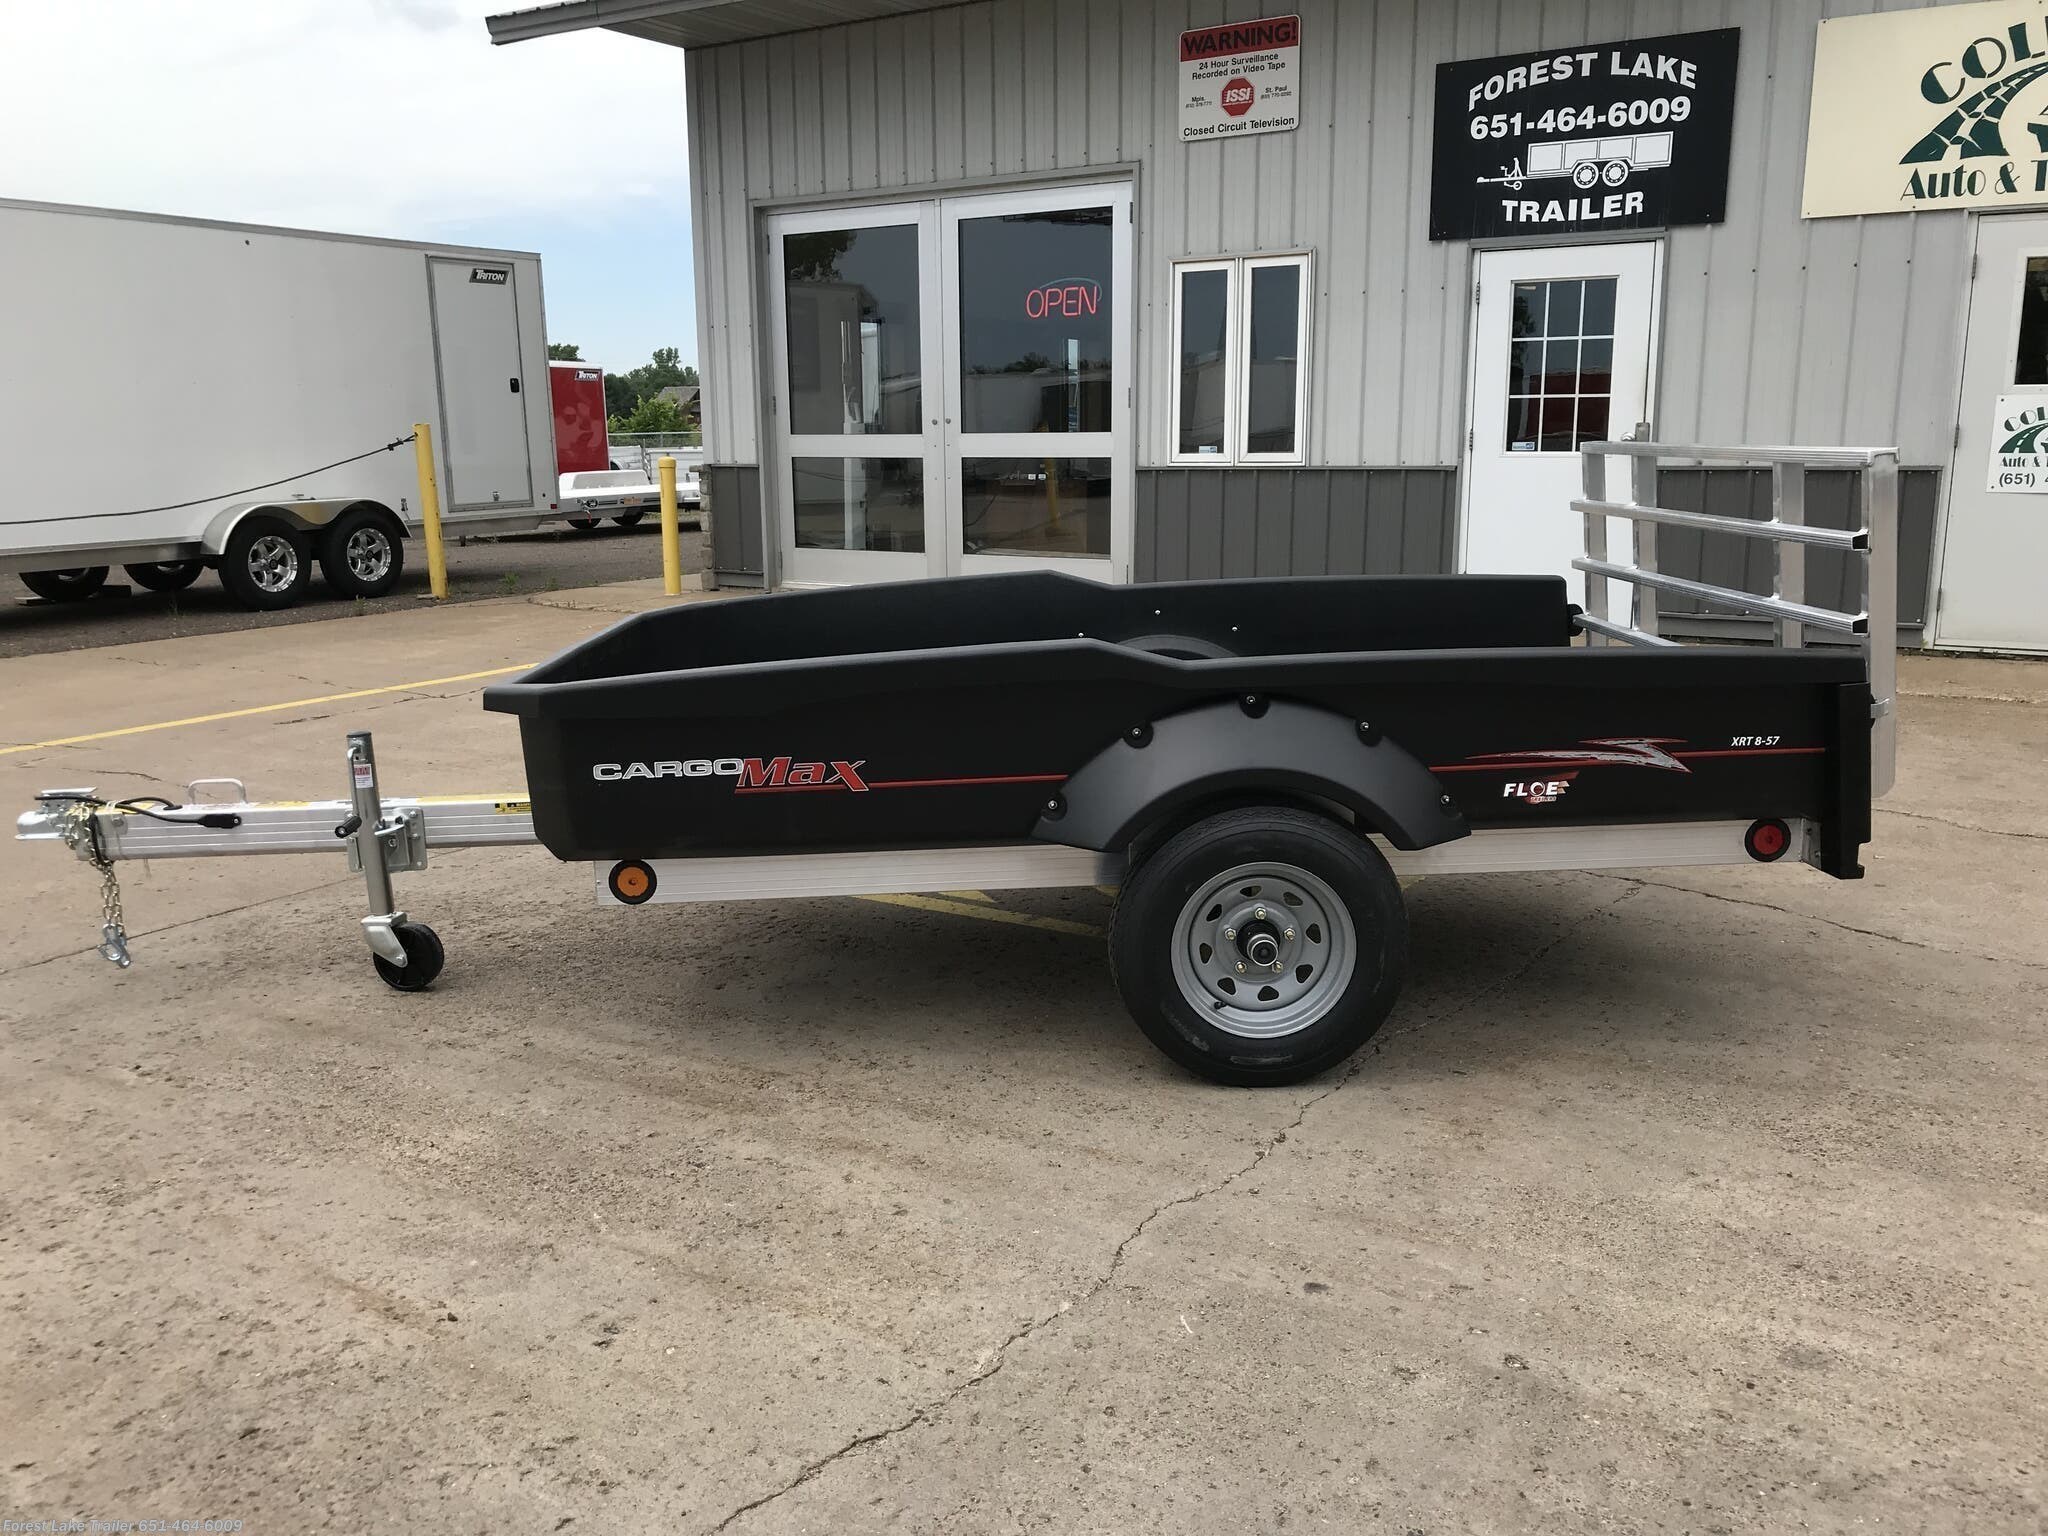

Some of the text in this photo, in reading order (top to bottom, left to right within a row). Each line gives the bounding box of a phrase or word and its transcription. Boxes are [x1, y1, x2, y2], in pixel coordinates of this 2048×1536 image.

[1183, 21, 1297, 56] WARNING!
[1199, 53, 1279, 70] 24 Hour Surveillance
[1920, 16, 2048, 105] COL
[1192, 69, 1229, 80] Recorded
[1243, 64, 1265, 74] Video
[1268, 62, 1286, 71] Tape
[1468, 51, 1698, 112] FOREST LAKE
[1226, 88, 1251, 103] ISSI
[1183, 116, 1295, 137] Closed Circuit Television
[1470, 95, 1692, 140] 651-464-6009
[1900, 164, 1987, 200] Auto
[1994, 161, 2021, 195] &
[1501, 191, 1645, 223] TRAILER
[475, 269, 505, 281] TRITON
[1026, 285, 1098, 318] OPEN
[577, 370, 598, 380] TRITON
[2000, 456, 2029, 468] Auto
[1999, 472, 2035, 488] (651)
[1731, 735, 1780, 746] XRT 8-57
[1503, 780, 1561, 798] FLOE
